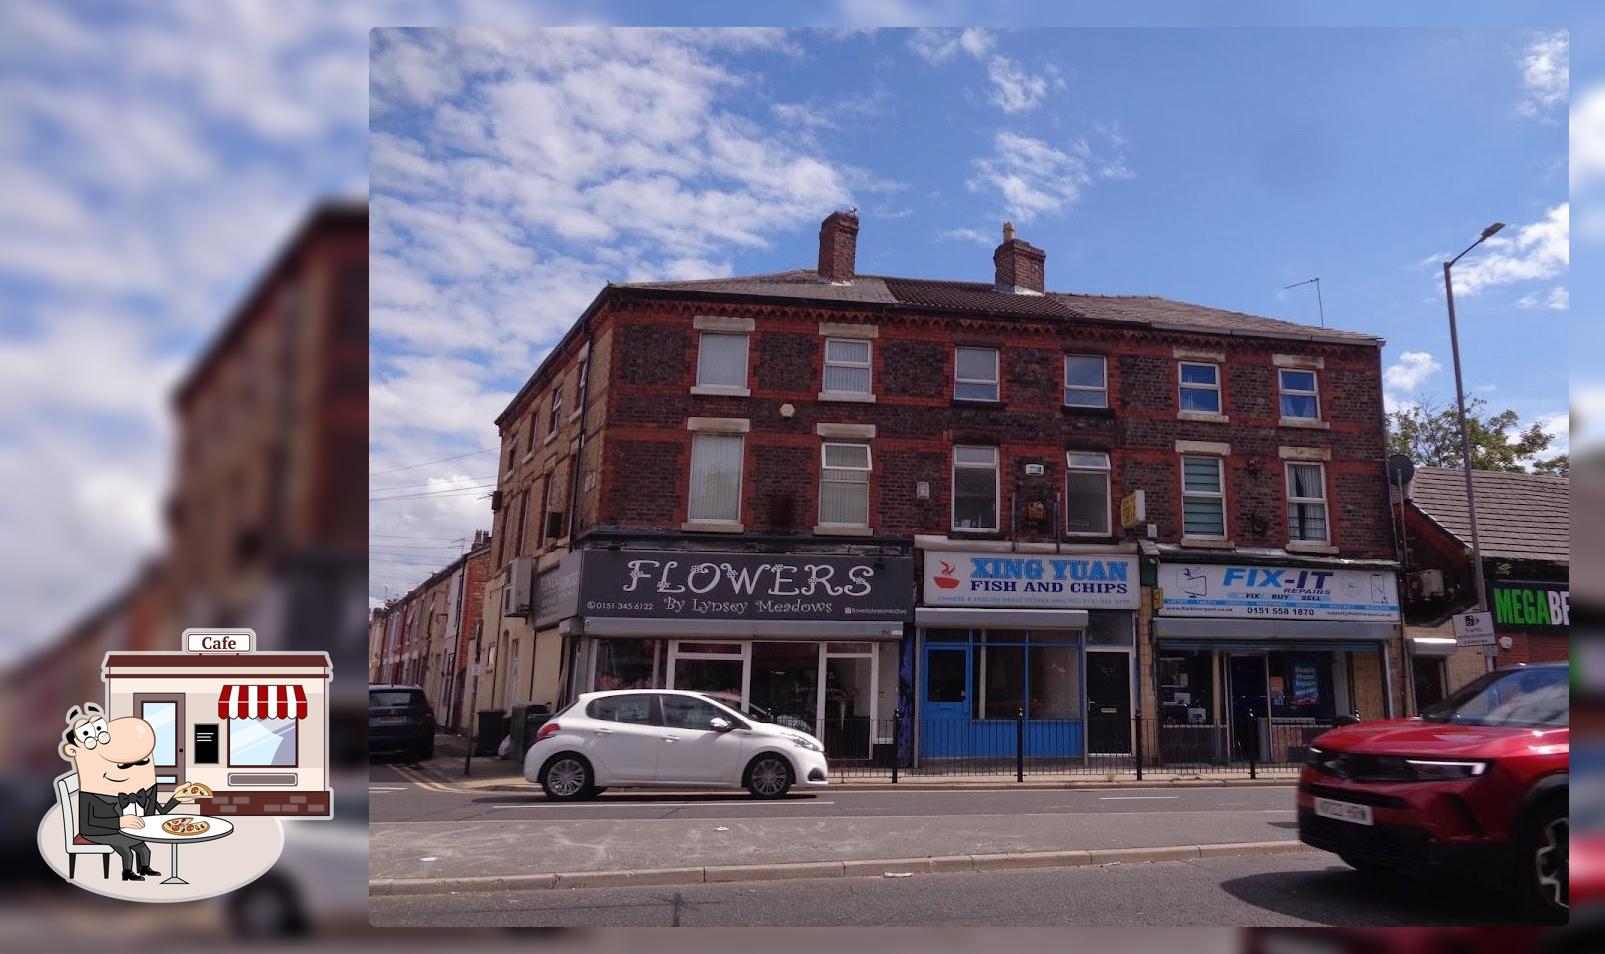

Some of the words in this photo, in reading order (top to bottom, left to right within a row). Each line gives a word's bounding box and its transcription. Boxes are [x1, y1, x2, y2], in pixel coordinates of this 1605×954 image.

[622, 559, 875, 596] FLOWERS
[970, 558, 1045, 580] XING
[1049, 559, 1129, 581] YUAN
[1222, 568, 1334, 589] FIX-IT
[970, 580, 1017, 592] FISH
[1024, 581, 1064, 593] AND
[1070, 582, 1128, 594] CHIPS
[596, 601, 615, 610] 0151
[618, 602, 633, 610] 345
[633, 602, 655, 611] 6122
[663, 596, 685, 613] By
[692, 599, 748, 614] Lynsey
[755, 599, 832, 613] Meadows
[1293, 608, 1315, 616] 1870
